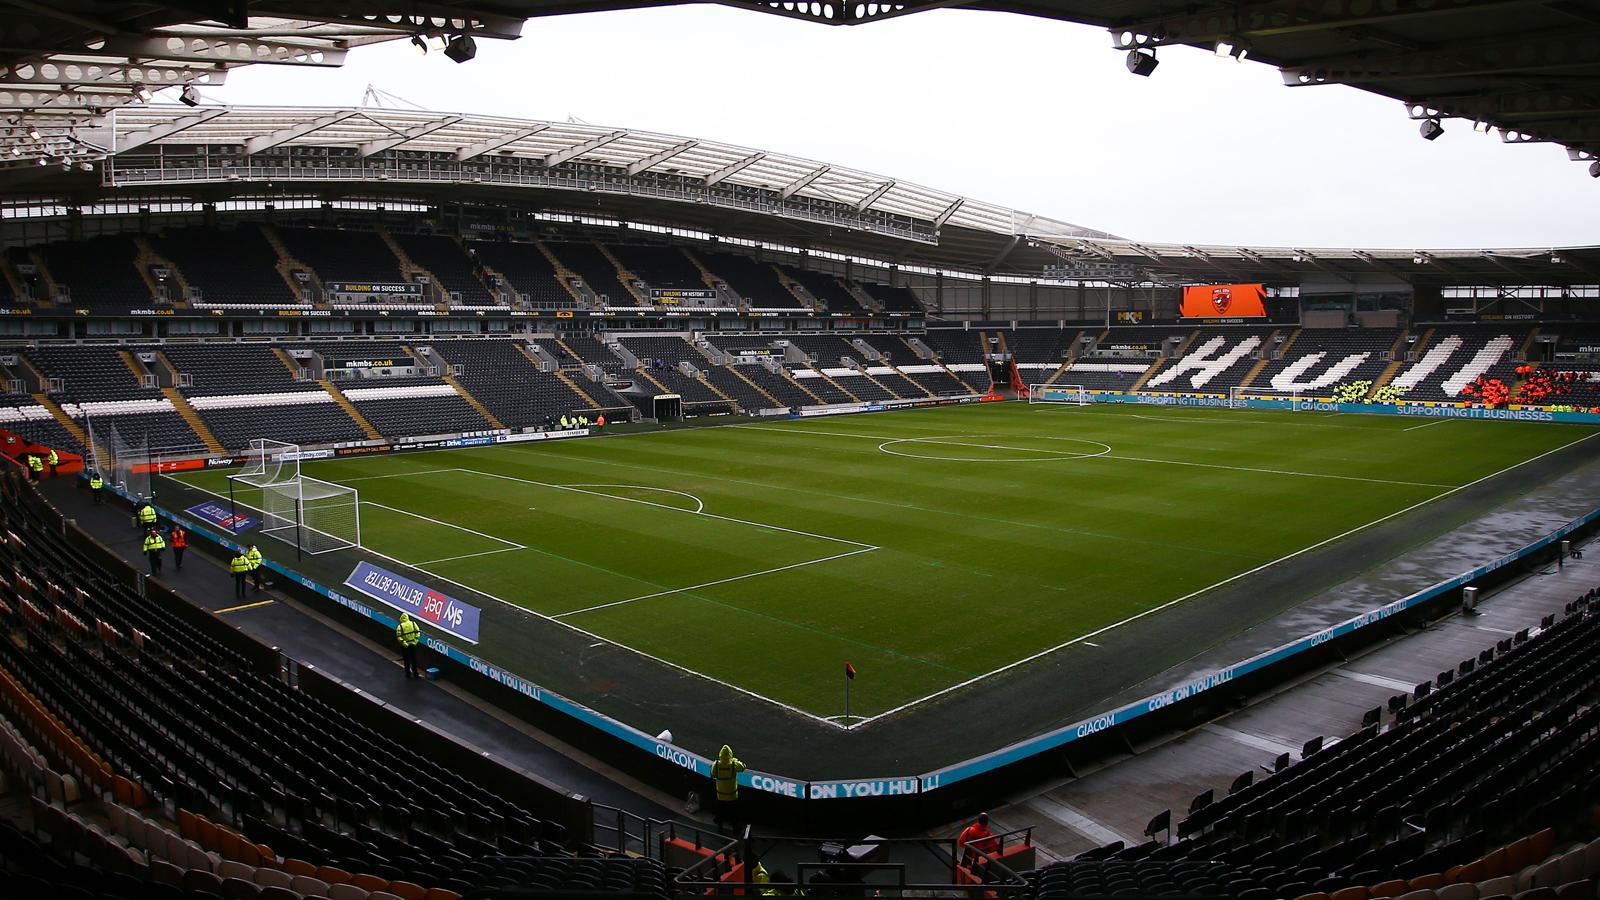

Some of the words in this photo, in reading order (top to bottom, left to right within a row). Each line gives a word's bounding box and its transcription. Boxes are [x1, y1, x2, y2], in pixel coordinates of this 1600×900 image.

[1117, 311, 1143, 324] MKM
[345, 359, 393, 368] mkmbs.co.uk
[1137, 395, 1188, 406] SUPPORTING
[1188, 397, 1198, 406] IT
[1199, 398, 1248, 408] BUSINESSES
[1301, 401, 1338, 411] GIACOM
[1397, 405, 1467, 417] SUPPORTING
[1469, 408, 1480, 418] IT
[1483, 408, 1553, 421] BUSINESSES
[208, 458, 233, 466] Nuway
[364, 570, 393, 592] BETTER
[389, 581, 424, 607] BETTING
[424, 595, 444, 621] bet
[443, 600, 464, 629] sky
[1353, 613, 1370, 630] COME
[1369, 611, 1380, 623] ON
[1379, 606, 1393, 619] YOU
[426, 638, 449, 657] GIACOM
[1310, 629, 1334, 647] GIACOM
[469, 658, 488, 677] COME
[489, 667, 501, 682] ON
[501, 672, 518, 689] YOU
[519, 681, 541, 701] HULL!
[1148, 694, 1175, 712] COME
[1175, 687, 1190, 701] ON
[1191, 681, 1210, 695] YOU
[1210, 669, 1234, 687] HULL!
[1077, 713, 1115, 738] GIACOM
[656, 743, 697, 772] GIACOM
[750, 775, 797, 798] COME
[842, 782, 884, 798] YOU
